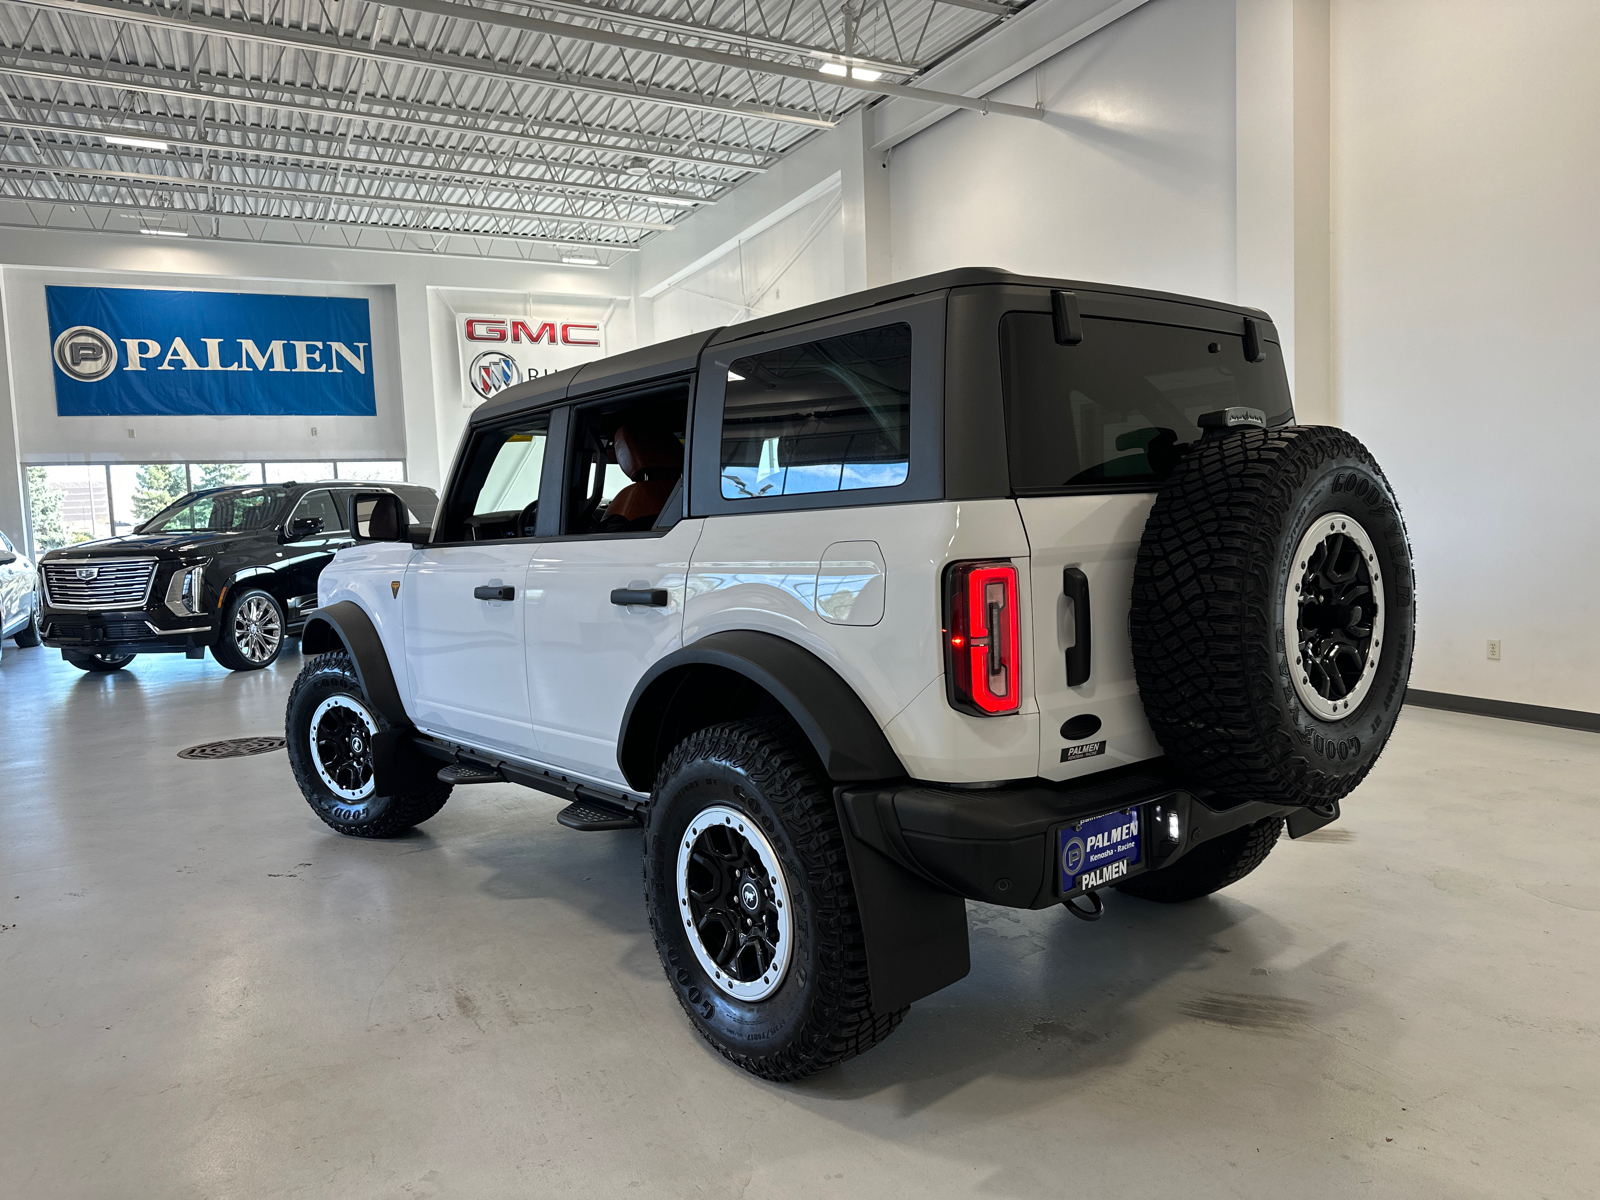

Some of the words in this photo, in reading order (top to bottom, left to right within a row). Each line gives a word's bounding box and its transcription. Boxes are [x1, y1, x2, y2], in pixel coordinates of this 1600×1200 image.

[465, 317, 600, 348] GMC
[120, 336, 368, 375] PALMEN
[1068, 742, 1100, 756] PALMEN
[1086, 821, 1139, 852] PALMEN
[1090, 849, 1113, 862] Kenosha
[1117, 841, 1135, 853] Racine
[1082, 860, 1127, 890] PALMEN
